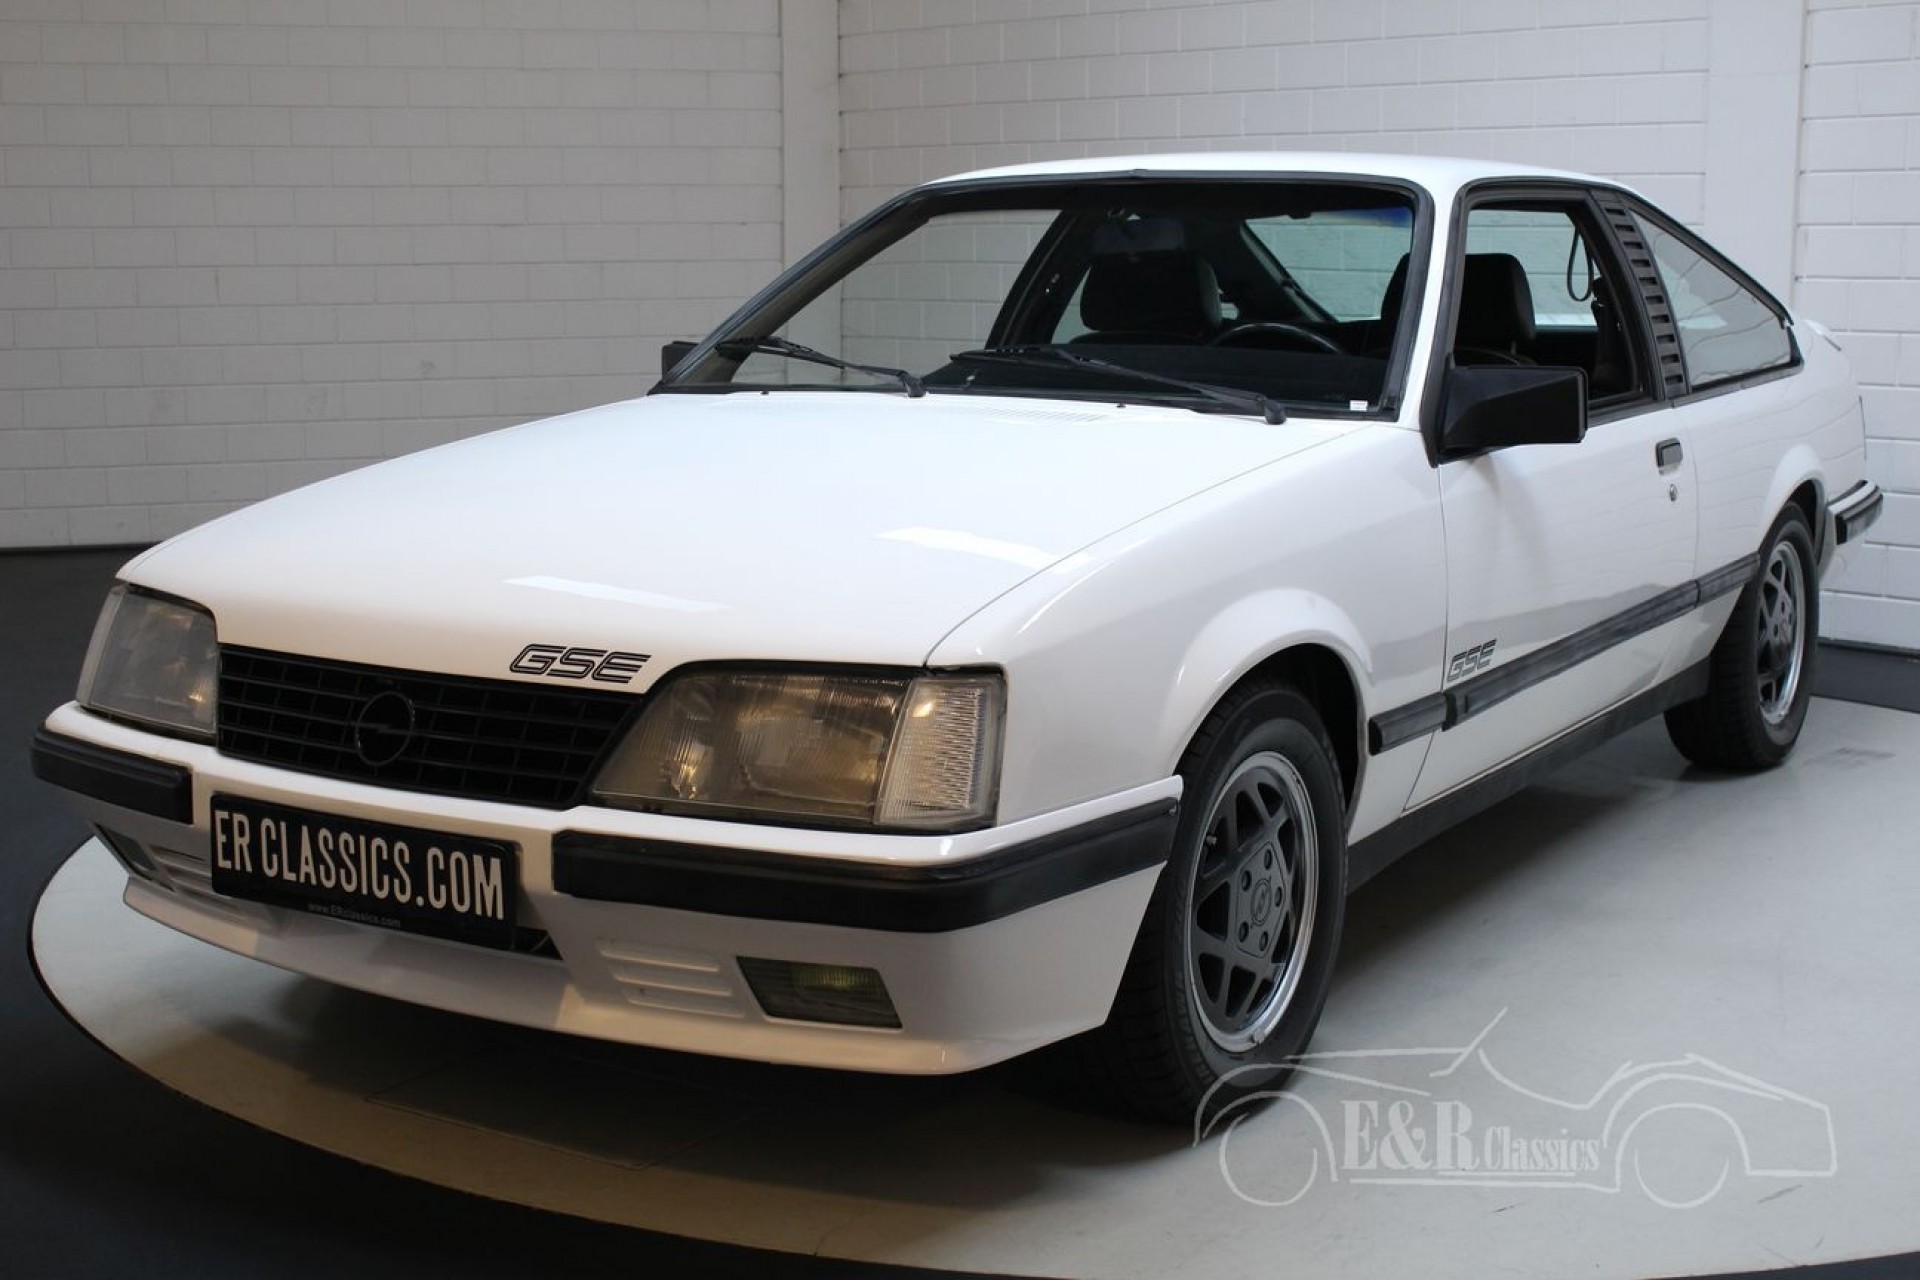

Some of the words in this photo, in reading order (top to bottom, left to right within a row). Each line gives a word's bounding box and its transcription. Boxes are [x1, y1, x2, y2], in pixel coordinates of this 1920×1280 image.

[509, 643, 652, 684] GSE
[1446, 639, 1497, 682] GSE
[215, 810, 252, 873] ER
[260, 818, 505, 921] CLASSICS.COM
